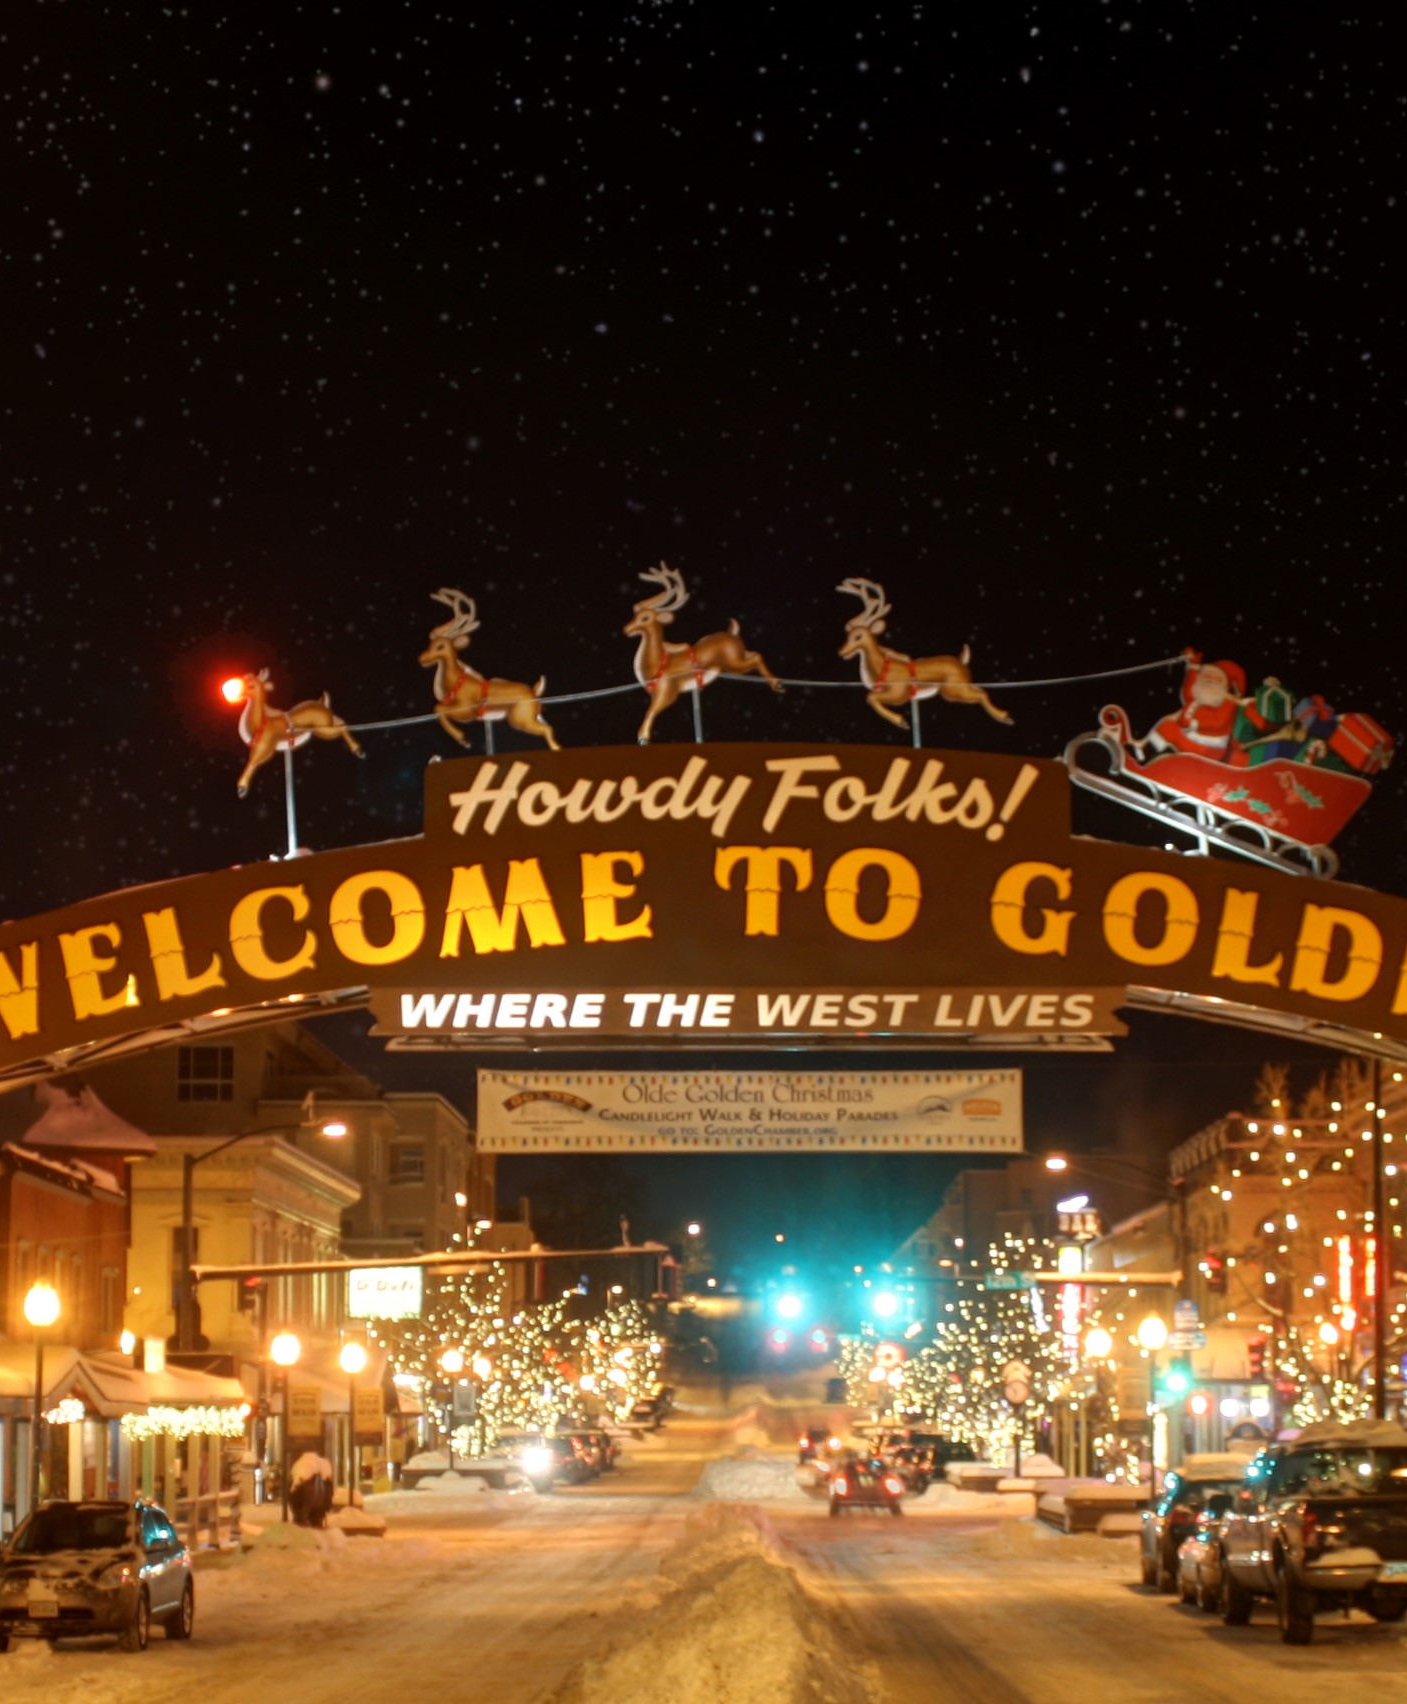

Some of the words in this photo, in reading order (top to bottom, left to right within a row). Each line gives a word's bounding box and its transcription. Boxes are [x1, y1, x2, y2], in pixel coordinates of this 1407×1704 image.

[449, 755, 751, 838] Howdy
[763, 755, 1040, 842] Folks!
[714, 846, 922, 941] TO
[400, 993, 605, 1028] WHERE
[623, 993, 735, 1028] THE
[756, 993, 917, 1028] WEST
[934, 993, 1094, 1028] LIVES
[623, 1084, 677, 1103] Olde
[685, 1085, 765, 1103] Golden
[772, 1084, 874, 1103] Christmas
[749, 1108, 762, 1122] &
[986, 1272, 1018, 1290] 12th
